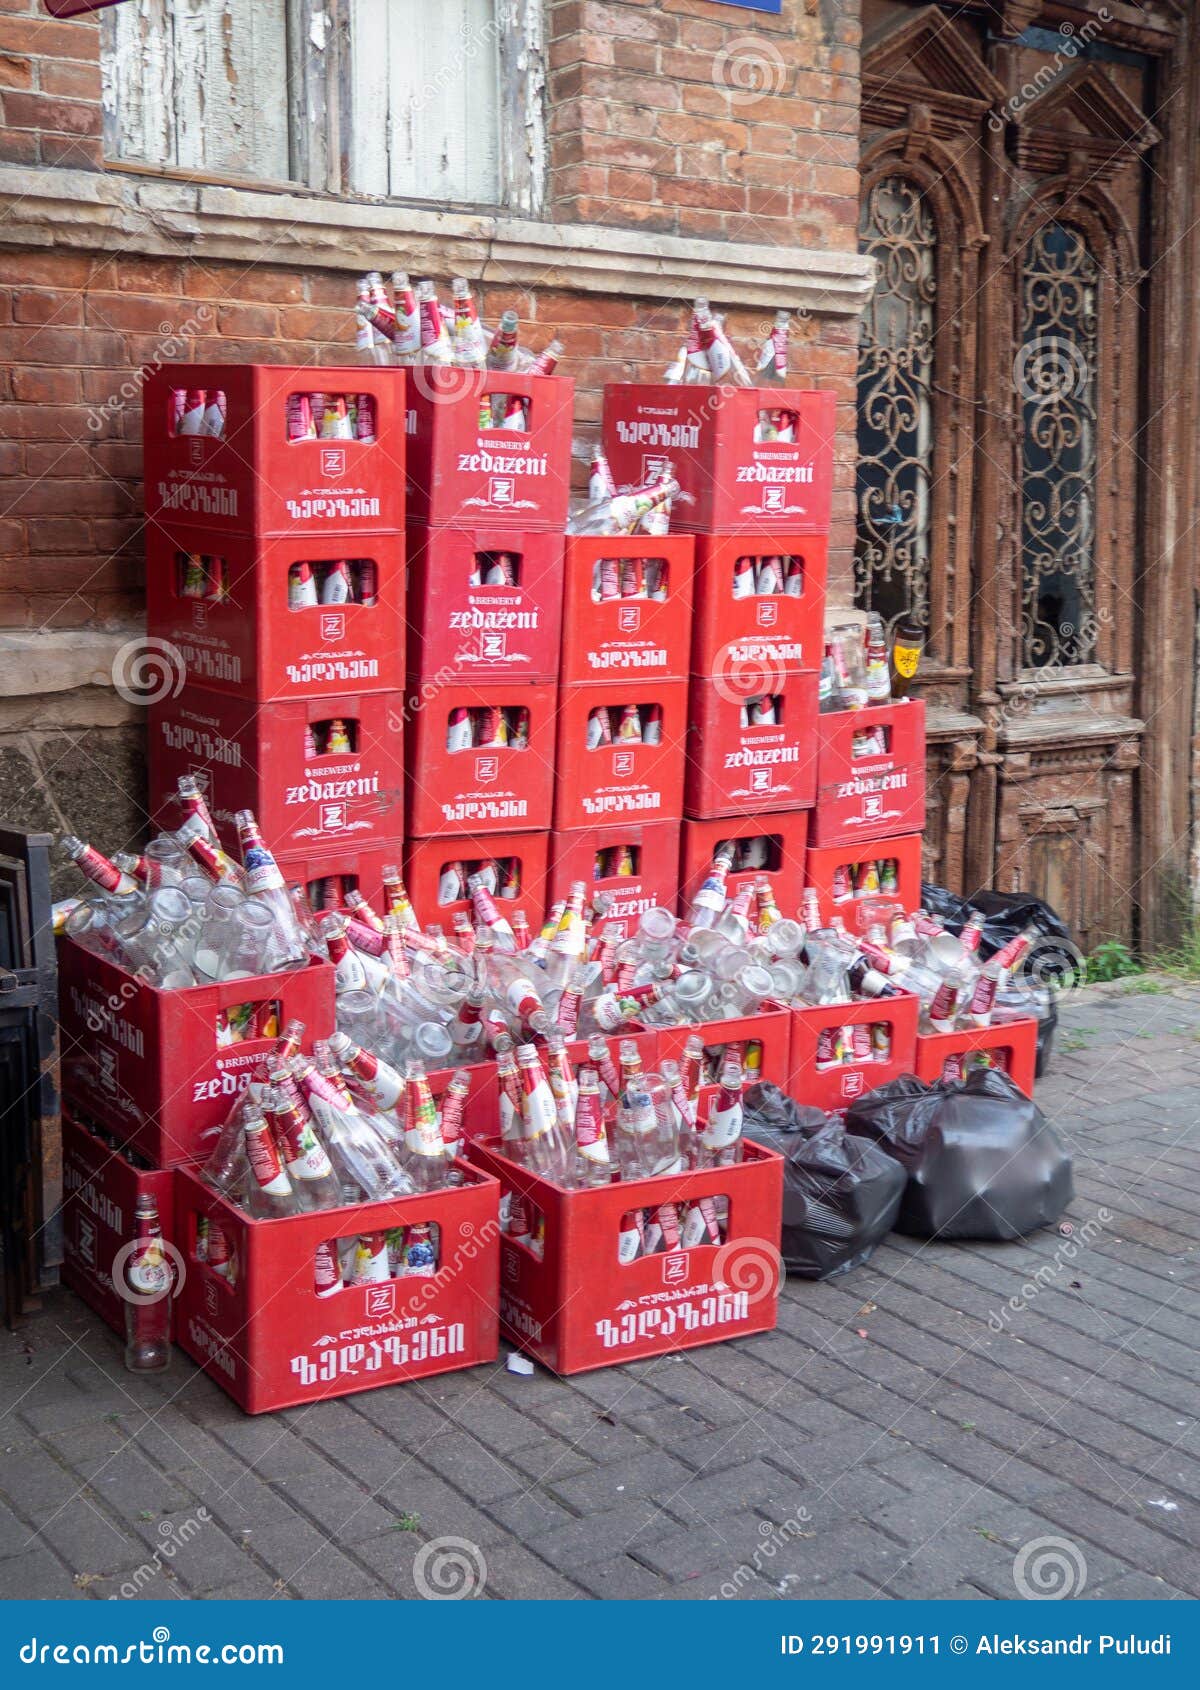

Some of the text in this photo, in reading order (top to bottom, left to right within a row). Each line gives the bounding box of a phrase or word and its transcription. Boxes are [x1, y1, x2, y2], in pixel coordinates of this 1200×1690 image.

[616, 421, 699, 448] ზედაზენი
[457, 450, 548, 475] zedazeni
[735, 461, 814, 483] zedazeni
[286, 498, 380, 519] ზედაზენი
[448, 606, 539, 629] zedazeni
[286, 659, 378, 683] ზედაზენი
[723, 742, 800, 768] zedazeni
[311, 765, 354, 776] BREWERY
[285, 771, 379, 805] zedazeni
[441, 800, 527, 820] ზედაზენი
[225, 1053, 268, 1068] BREWER
[192, 1071, 252, 1102] zeda
[595, 1291, 748, 1347] ზედაზენი
[290, 1323, 464, 1385] ზედაზენი
